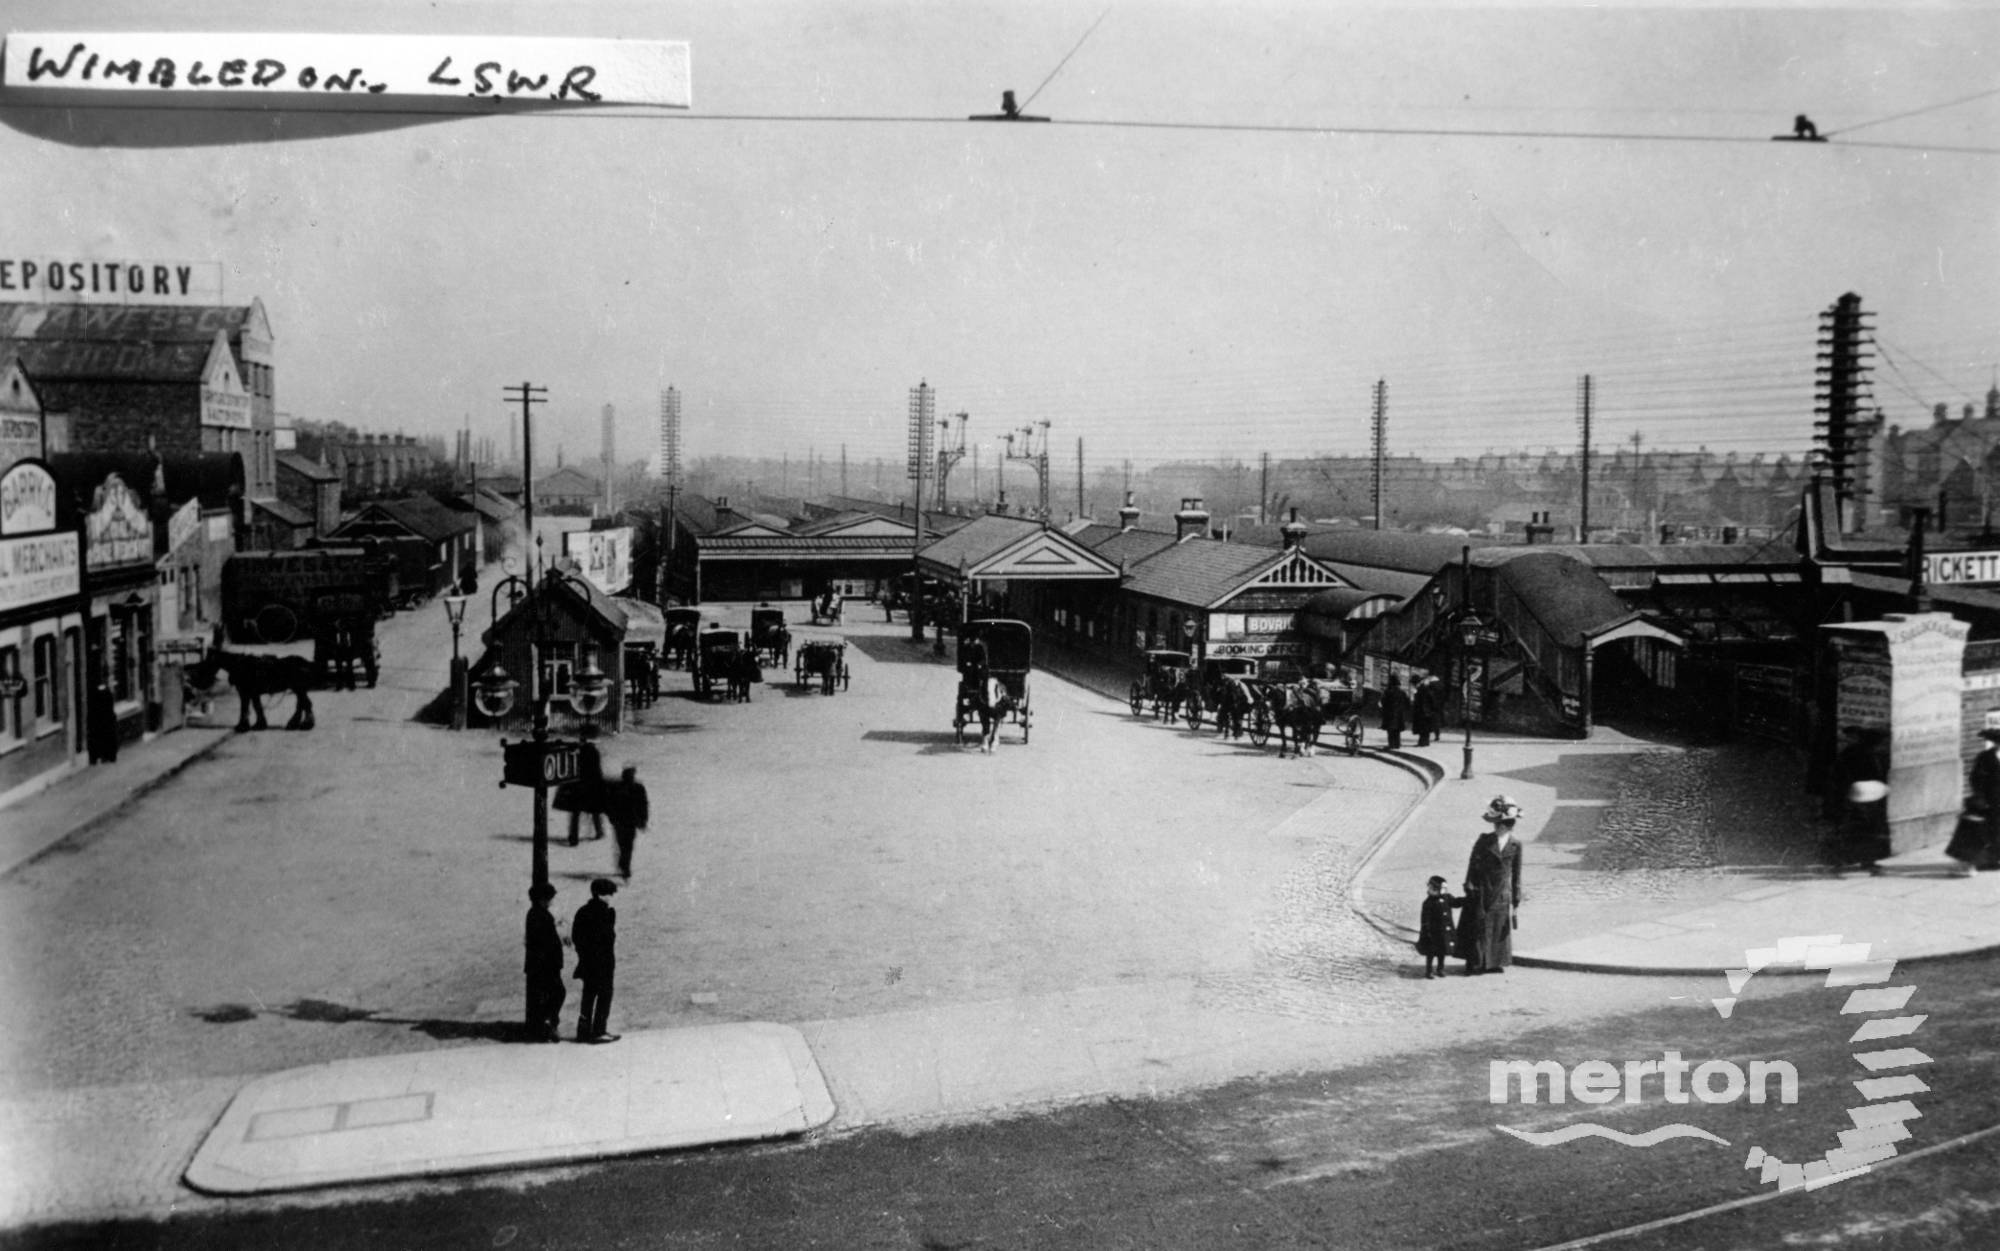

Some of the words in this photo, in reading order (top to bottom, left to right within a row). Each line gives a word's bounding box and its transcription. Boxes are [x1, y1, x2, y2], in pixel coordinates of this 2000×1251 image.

[0, 260, 191, 296] EPOSITORY
[1250, 616, 1295, 631] BOVRIL
[1218, 644, 1265, 655] BOOKING
[543, 748, 581, 781] OUT
